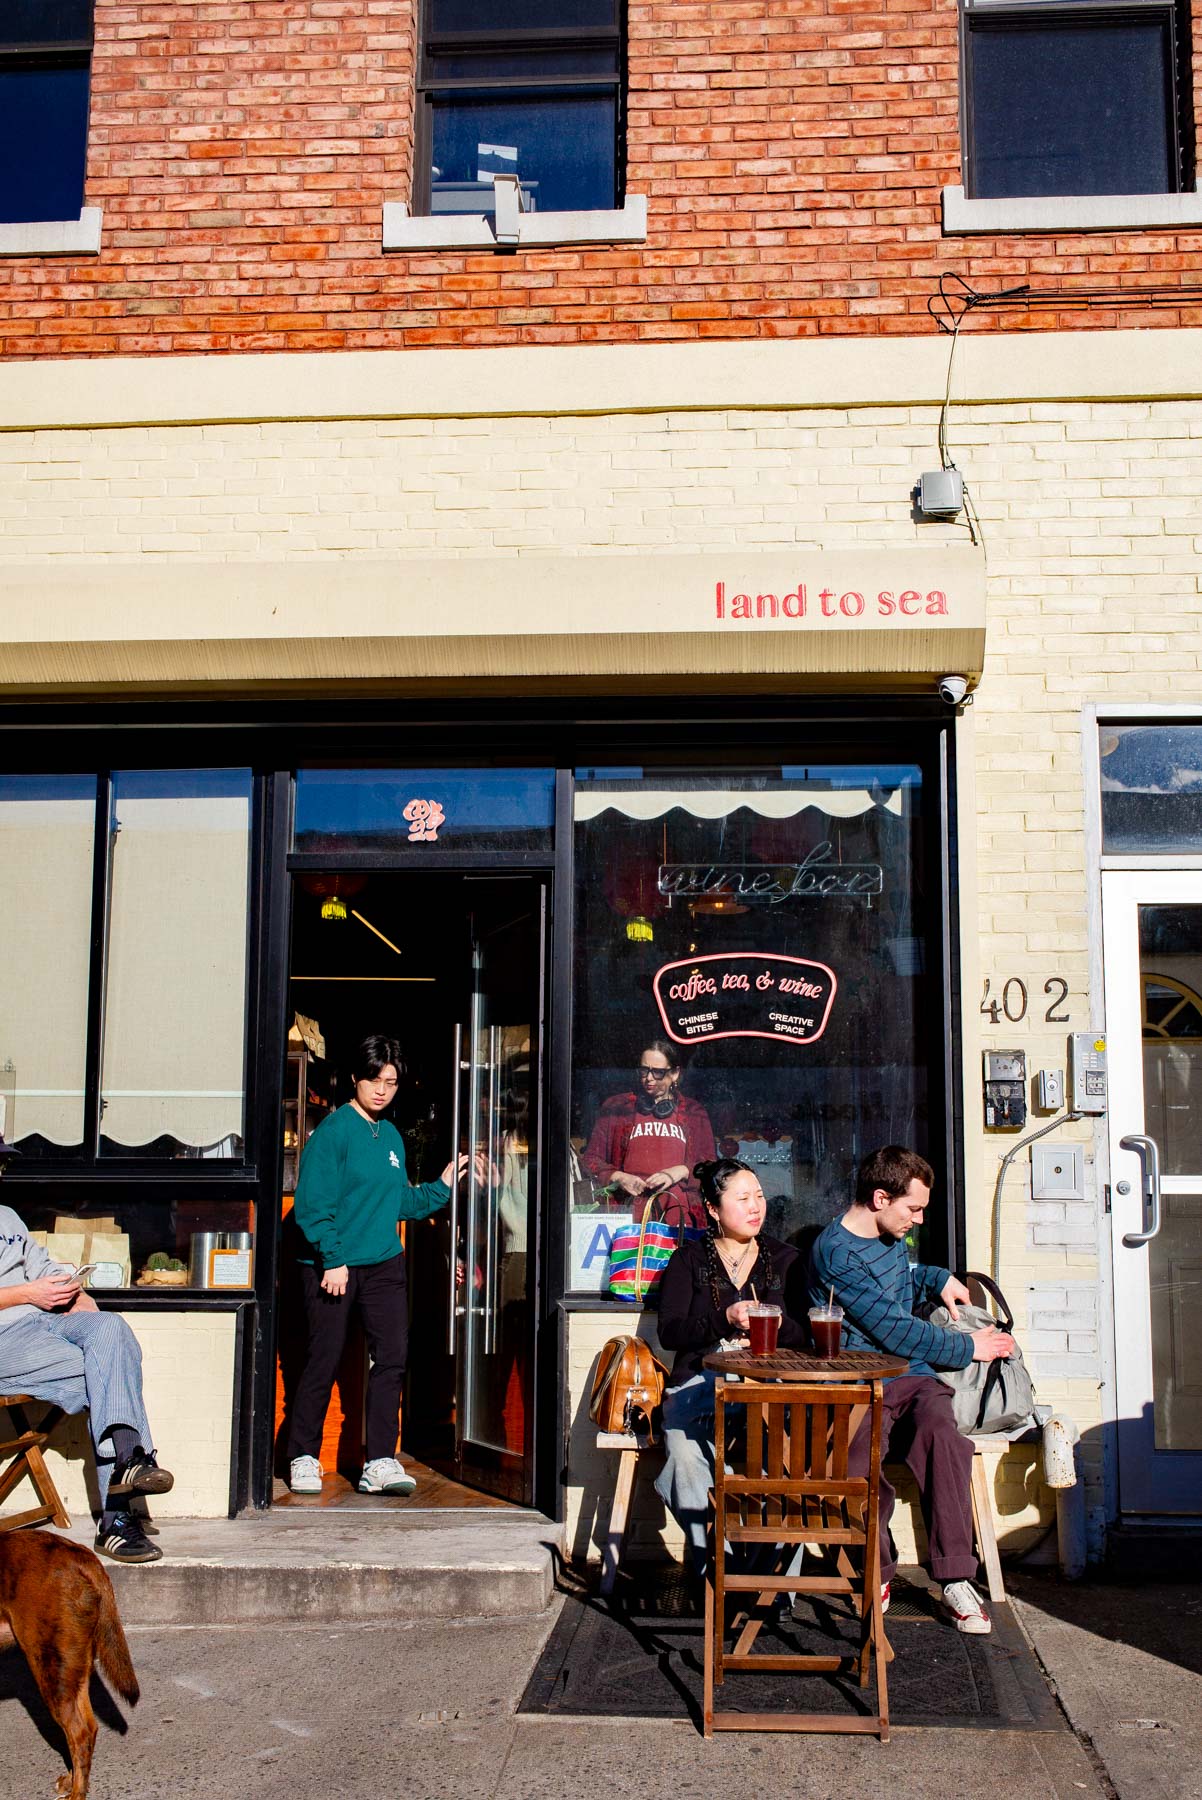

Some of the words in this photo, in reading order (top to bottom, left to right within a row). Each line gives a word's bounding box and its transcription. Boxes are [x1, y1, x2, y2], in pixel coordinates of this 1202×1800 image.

[716, 582, 807, 618] land
[818, 588, 865, 617] to
[877, 590, 949, 616] sea
[669, 973, 718, 1002] coffee,
[755, 970, 775, 991] &
[778, 976, 823, 999] wine
[980, 977, 1070, 1023] 402
[678, 1011, 719, 1026] CHINESE
[686, 1022, 715, 1035] BITES
[768, 1012, 815, 1027] CREATIVE
[774, 1023, 806, 1036] SPACE
[581, 1223, 613, 1269] A
